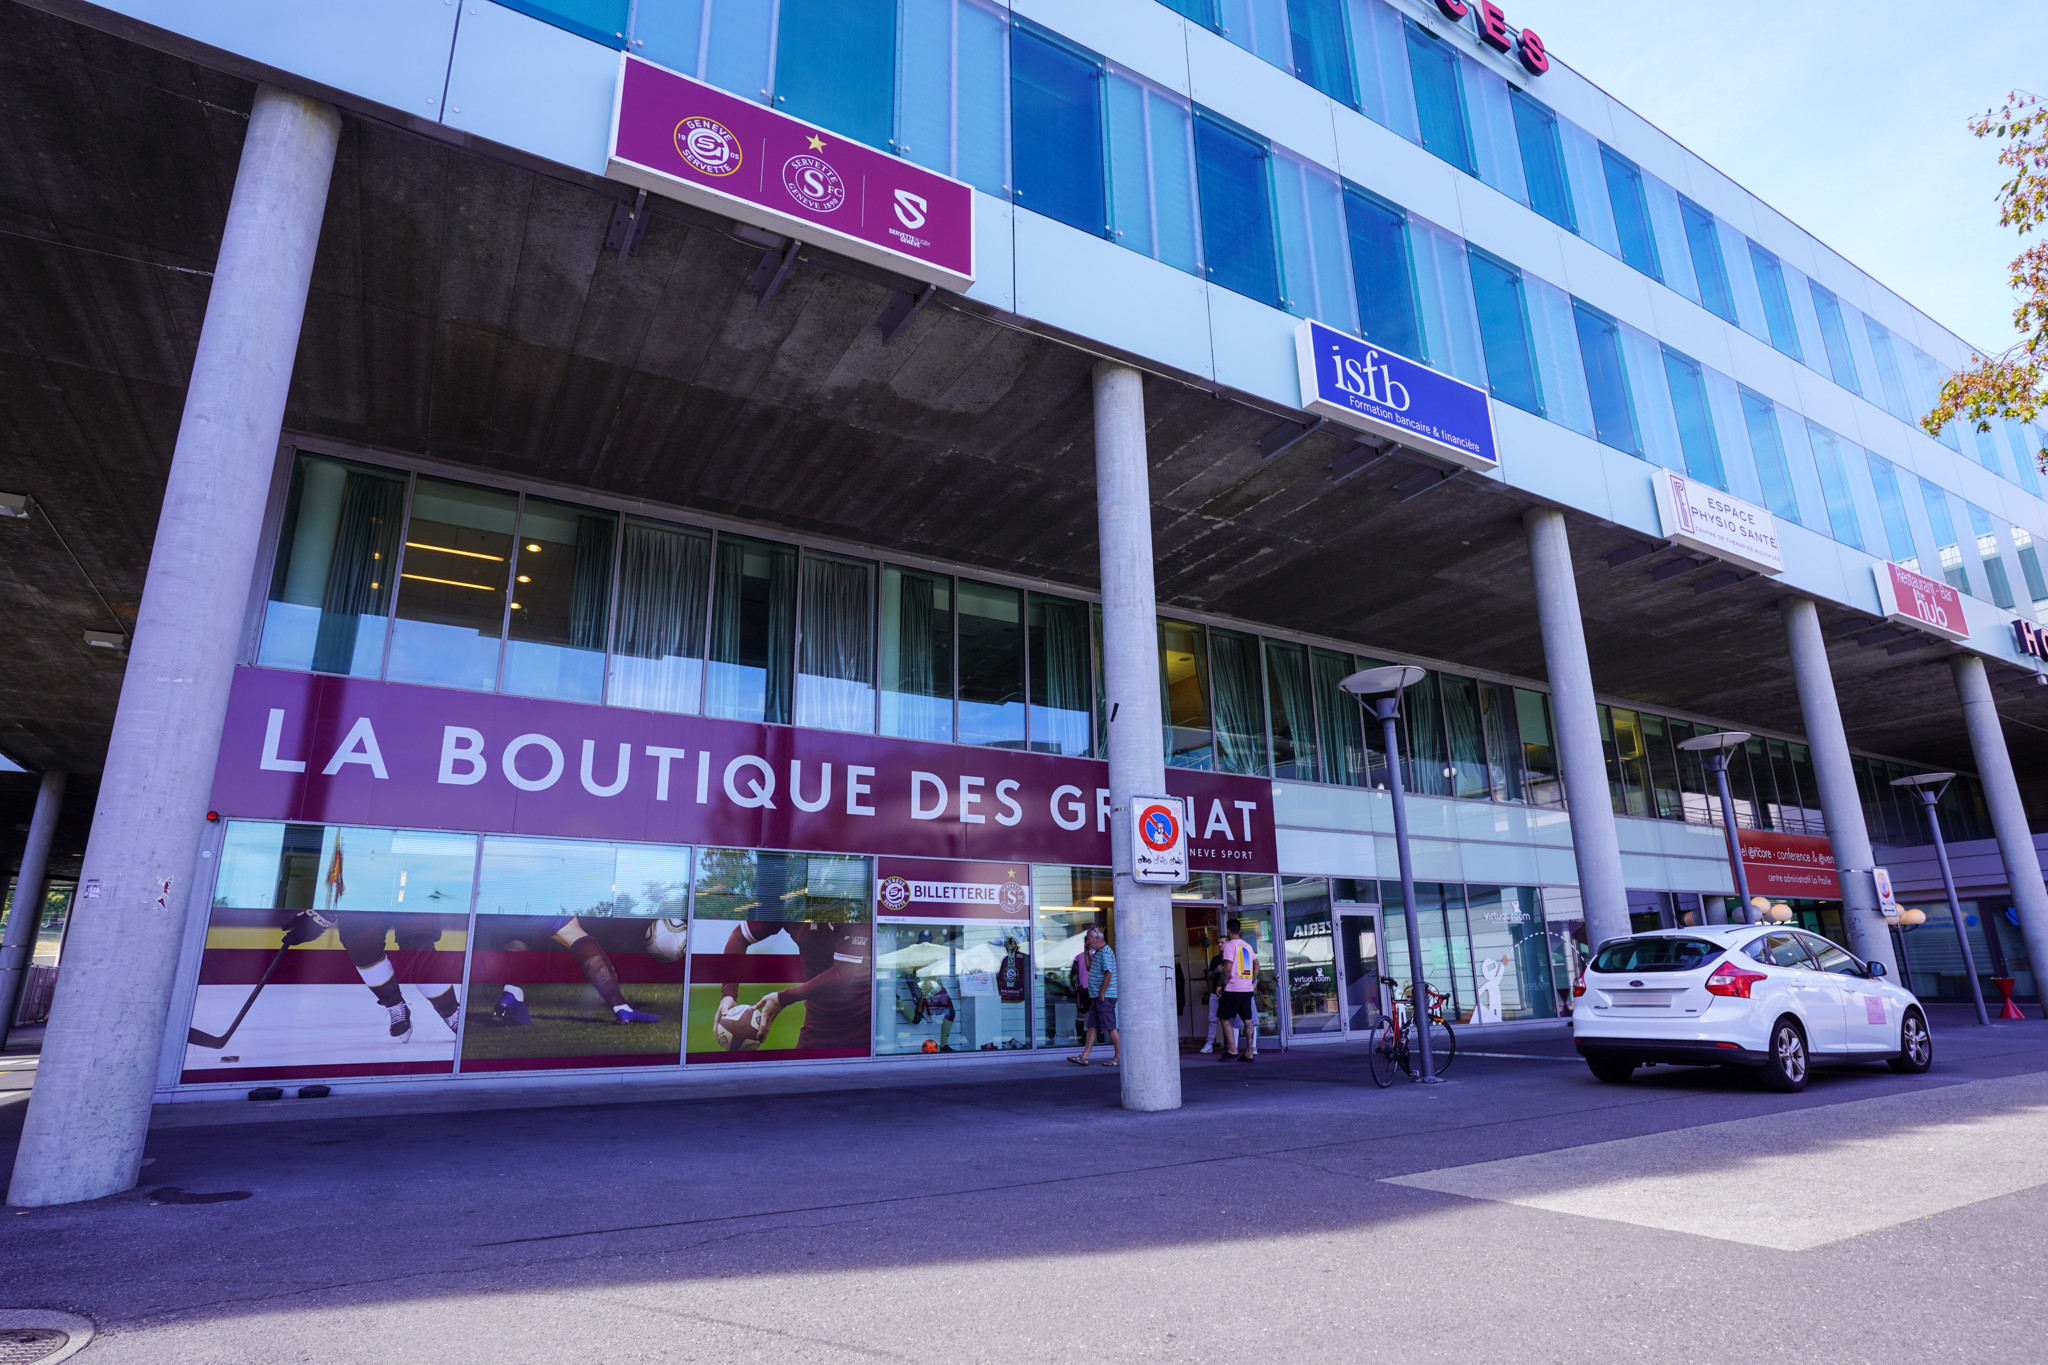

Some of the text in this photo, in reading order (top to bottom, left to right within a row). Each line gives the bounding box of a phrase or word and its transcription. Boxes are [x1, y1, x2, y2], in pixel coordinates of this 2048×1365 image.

[686, 119, 733, 142] GENEVE
[682, 149, 732, 174] SERVETTE
[791, 158, 838, 183] SERVETTE
[788, 182, 839, 210] GENEVE 1890
[827, 185, 843, 198] FC
[1331, 345, 1411, 411] isfb
[1349, 395, 1480, 452] Formation bancaire & financière
[1707, 497, 1756, 526] ESPACE
[1690, 506, 1778, 549] PHYSIO SANTÉ
[1695, 526, 1717, 538] CENTRE
[1894, 566, 1936, 596] Restaurant
[1939, 584, 1953, 602] Bar
[1912, 588, 1948, 628] hub
[259, 707, 389, 780] LA
[437, 725, 876, 818] BOUTIQUE
[911, 769, 1022, 827] DES
[1221, 850, 1253, 860] SPORT
[1777, 847, 1811, 863] conference
[1811, 851, 1818, 863] &
[1768, 874, 1783, 883] centre
[1783, 873, 1811, 884] administratif
[1817, 875, 1832, 886] Praille
[914, 885, 995, 901] BILLETTERIE
[1483, 911, 1531, 921] virtual room
[1294, 975, 1314, 983] virtual
